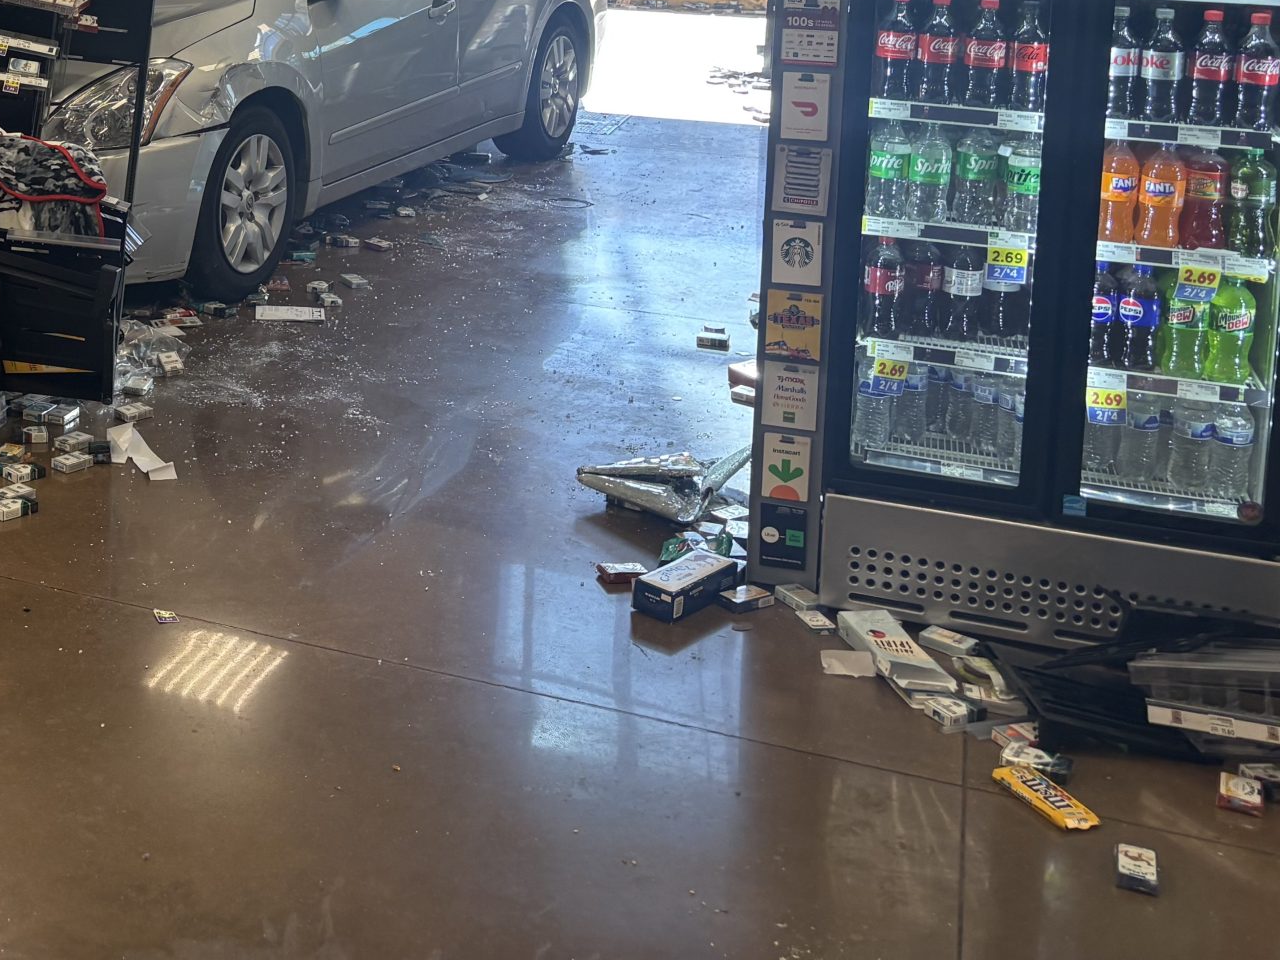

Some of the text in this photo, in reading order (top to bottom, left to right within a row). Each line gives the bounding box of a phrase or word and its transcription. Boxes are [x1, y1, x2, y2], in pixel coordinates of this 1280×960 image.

[786, 16, 814, 27] 100s
[878, 32, 916, 49] Coca-Cola
[966, 41, 1006, 58] Coca-Cola
[1142, 55, 1170, 70] oke
[1006, 169, 1039, 185] prite
[1145, 180, 1175, 193] FANTA
[790, 198, 818, 206] CHIPOTLE
[991, 250, 1023, 264] 2.69
[1183, 269, 1217, 285] 2.69
[1120, 305, 1142, 315] PEPSI
[877, 362, 905, 377] 2.69
[775, 384, 807, 395] Marshalls
[773, 394, 807, 403] HomeGoods
[1091, 392, 1122, 407] 2.69
[772, 447, 801, 457] instacart
